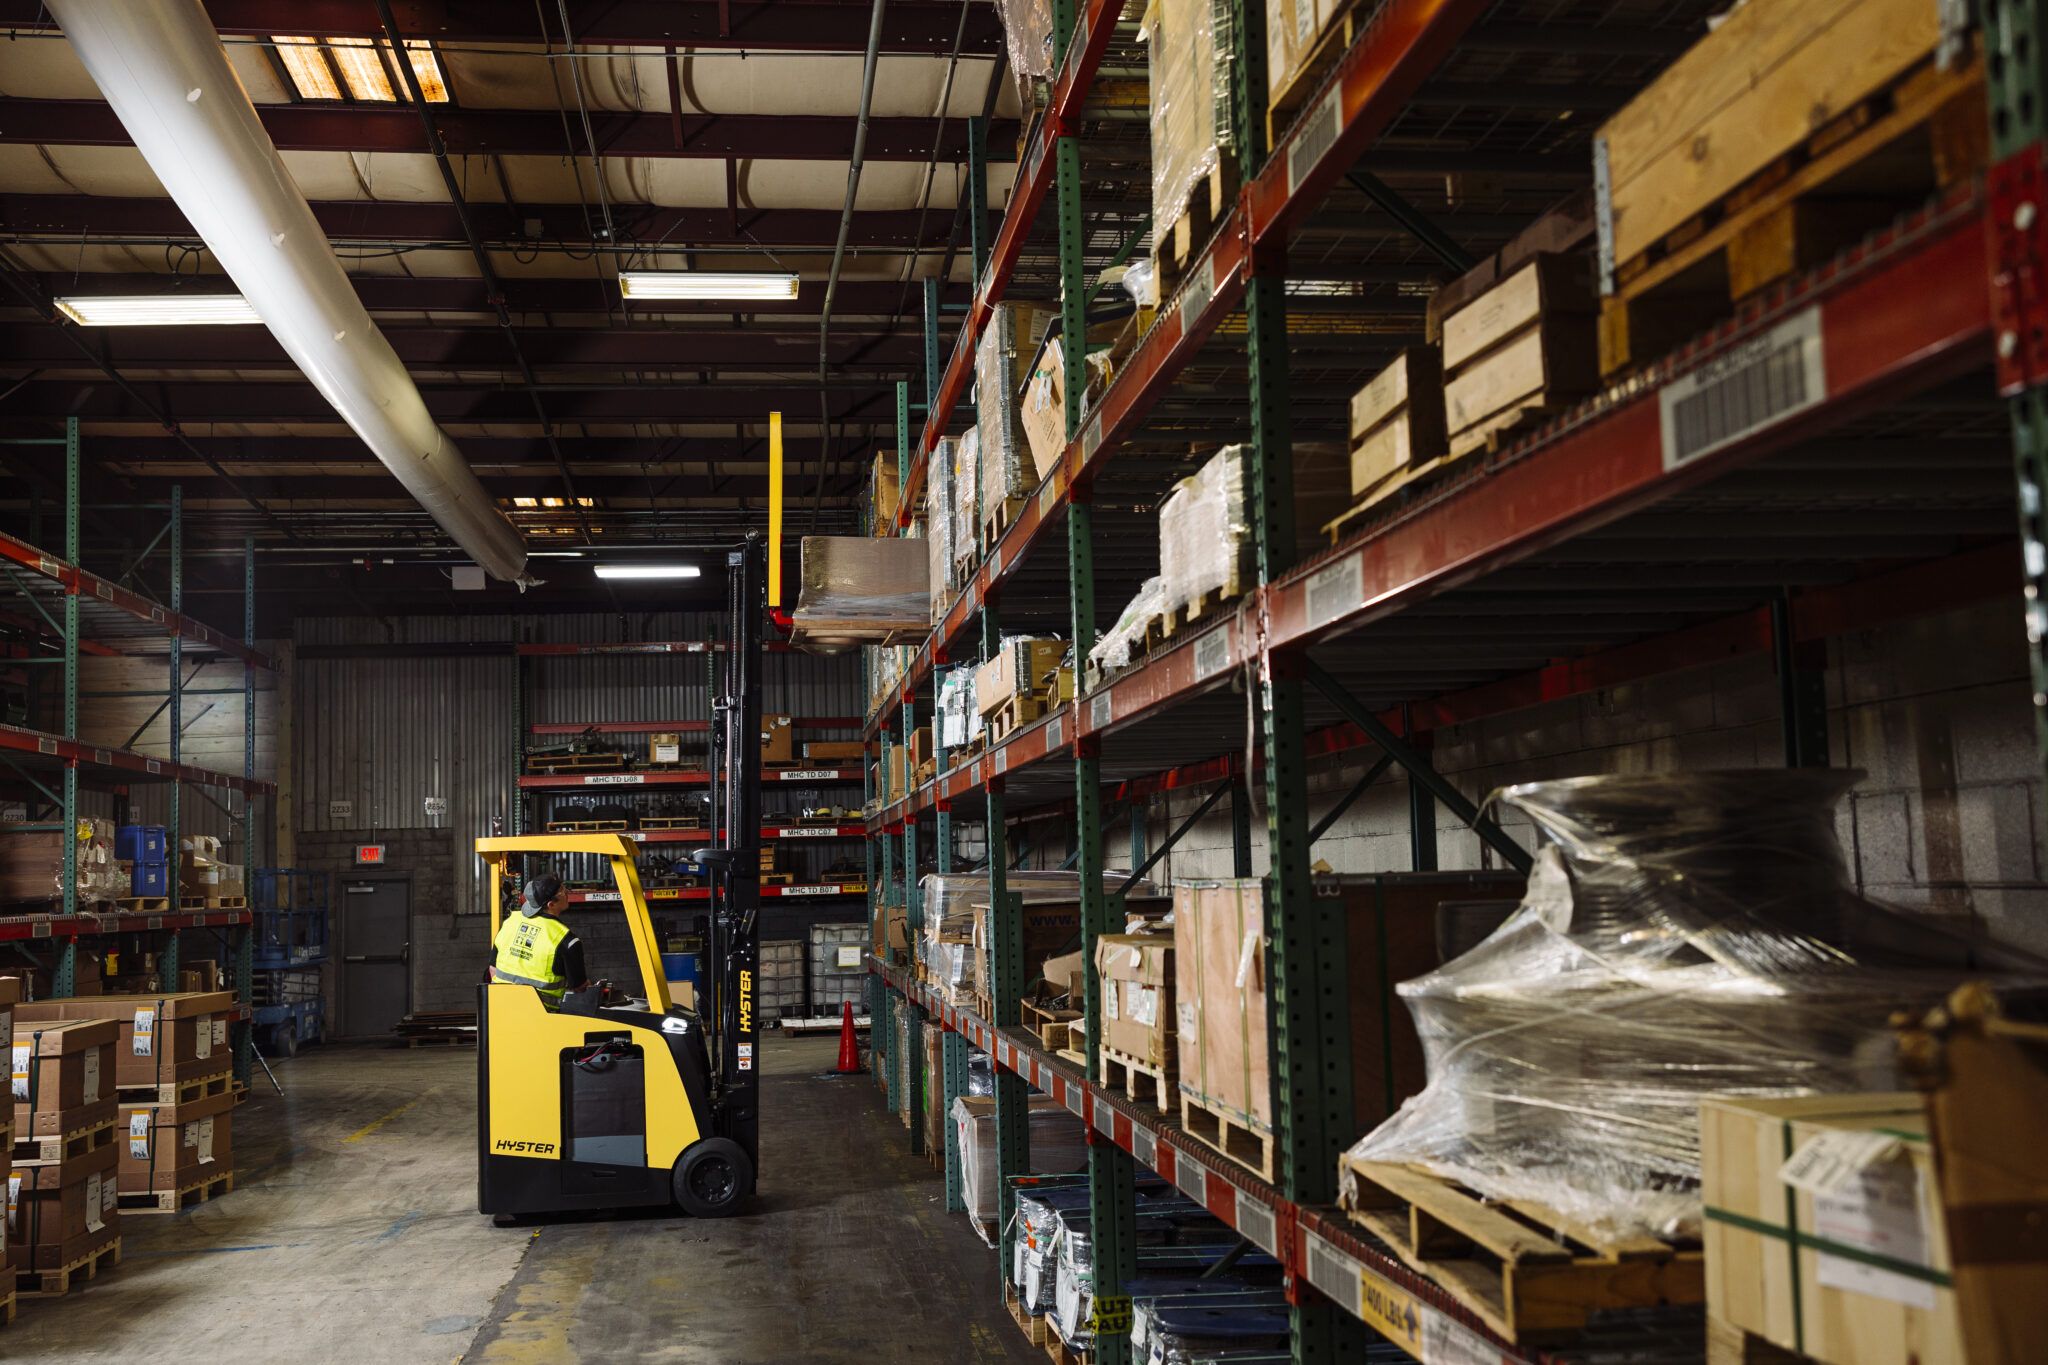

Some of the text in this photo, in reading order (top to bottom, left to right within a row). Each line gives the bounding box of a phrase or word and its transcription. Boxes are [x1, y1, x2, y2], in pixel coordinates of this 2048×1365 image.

[361, 847, 379, 861] EXIT
[740, 970, 751, 1033] HYSTER
[495, 1139, 555, 1154] HYSTER
